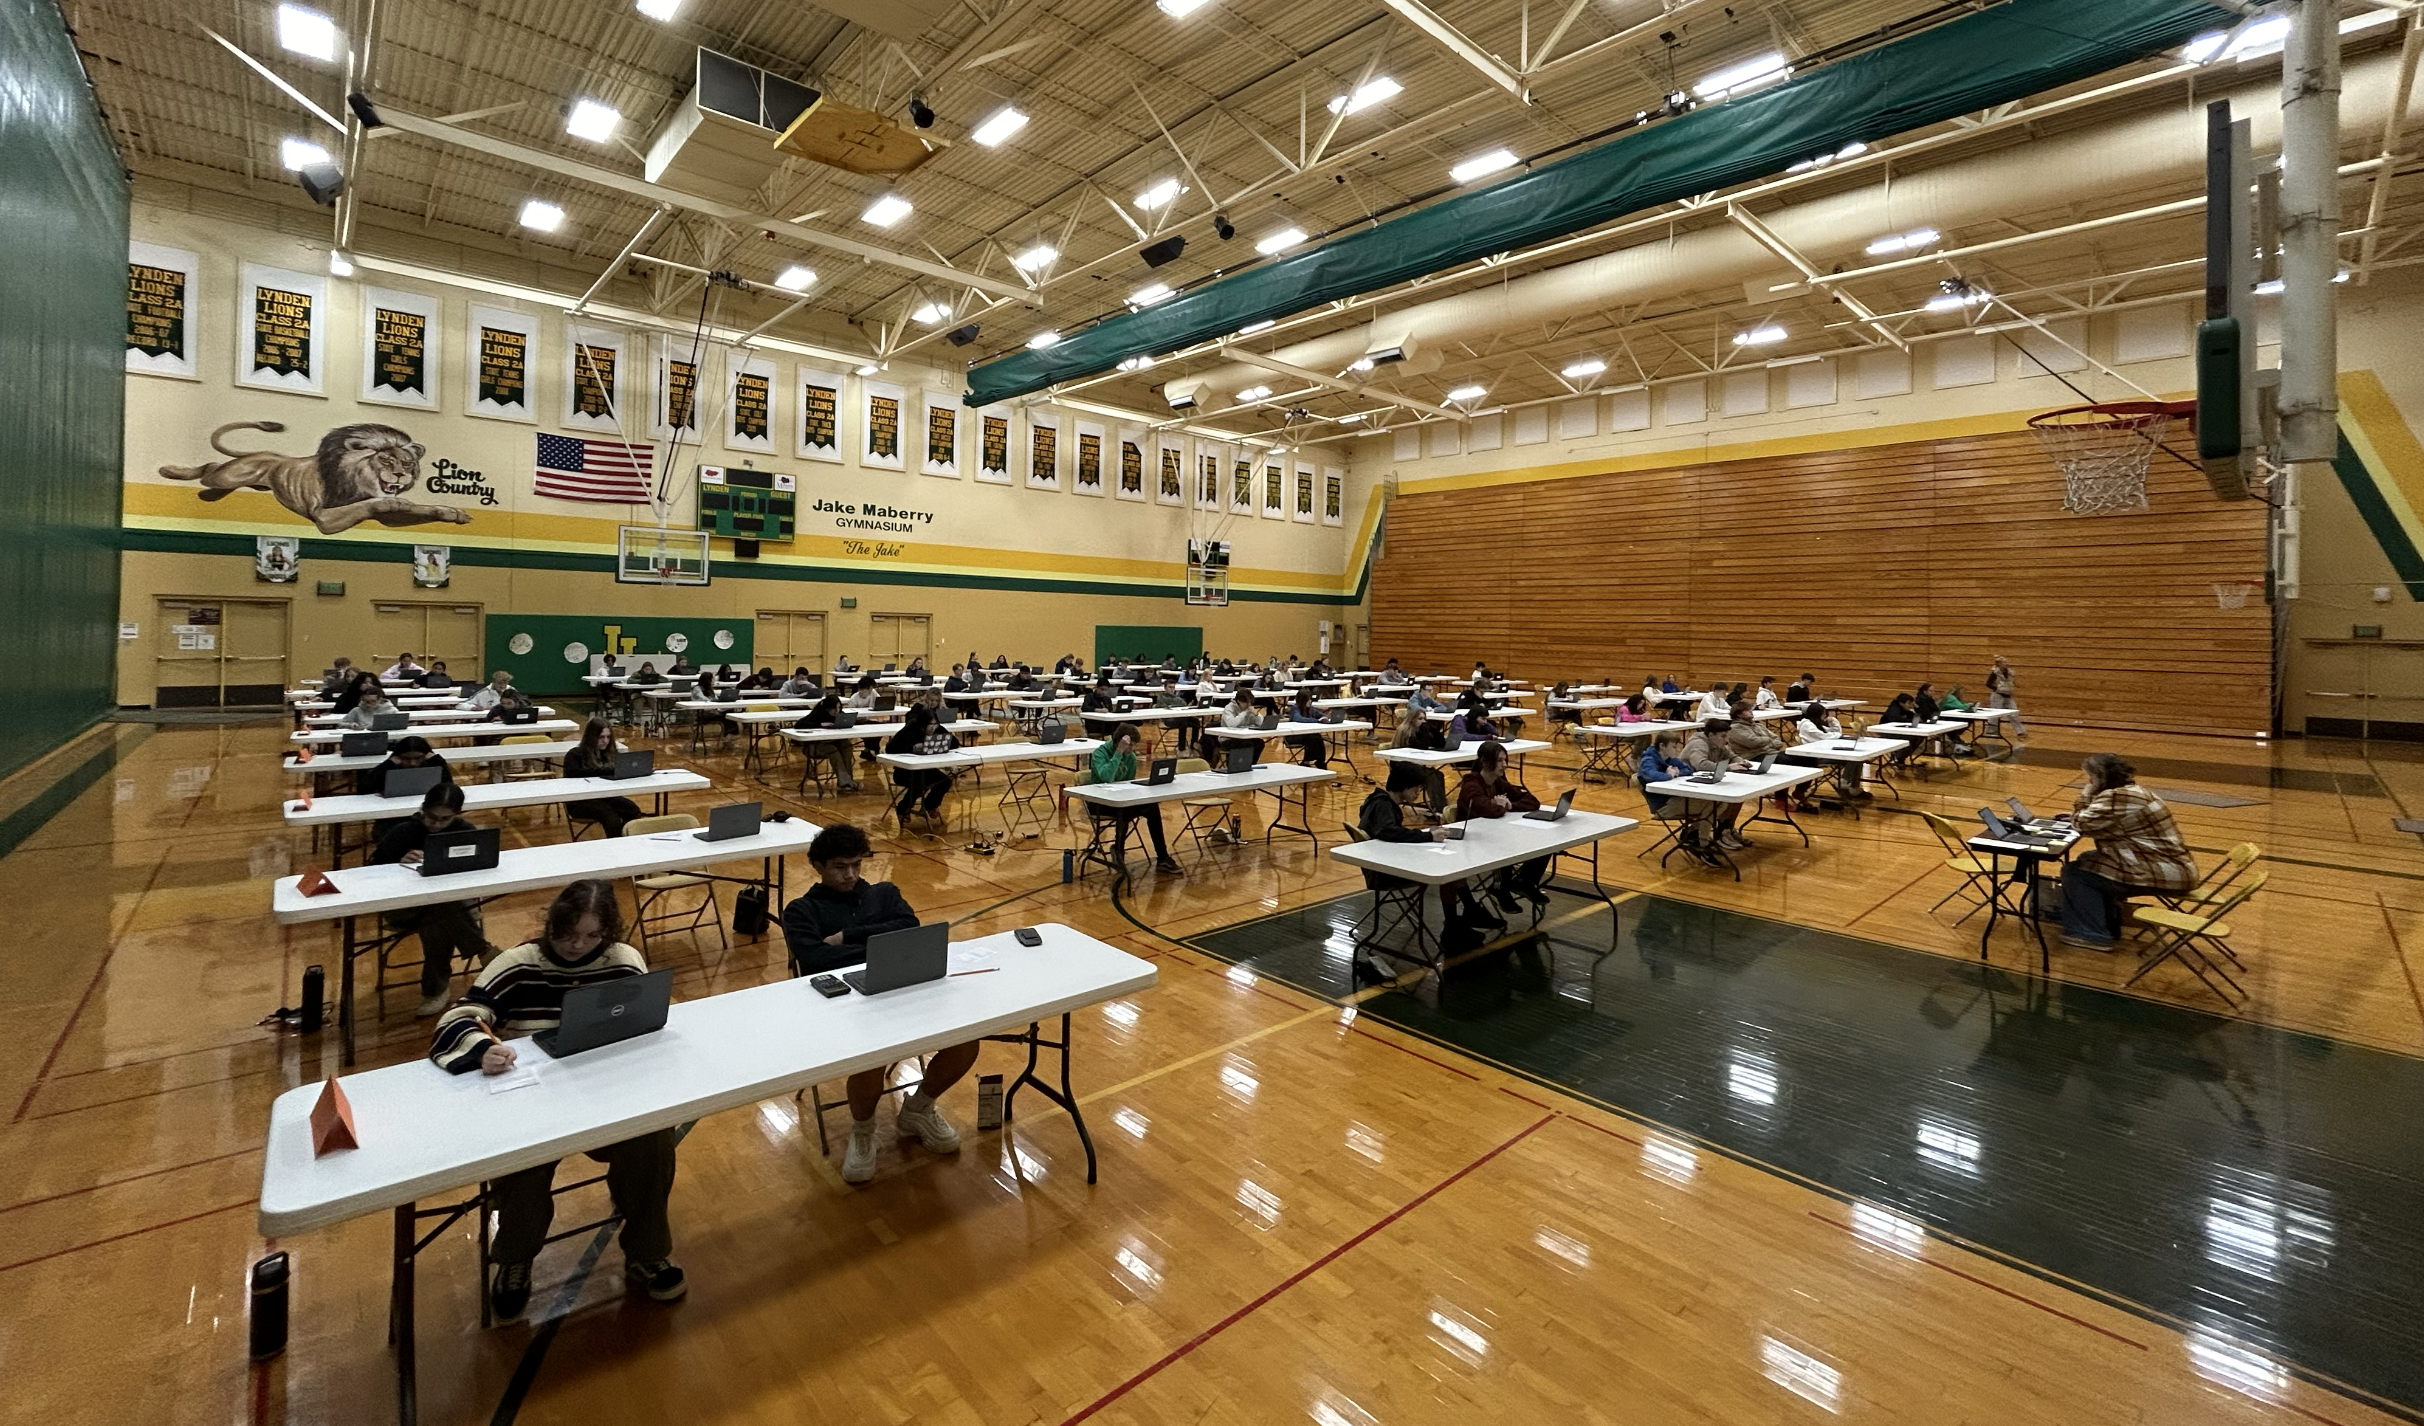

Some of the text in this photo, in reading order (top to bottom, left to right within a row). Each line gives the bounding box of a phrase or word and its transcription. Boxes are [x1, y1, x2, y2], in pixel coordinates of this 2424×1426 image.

[128, 265, 183, 286] YNDEN
[131, 279, 175, 297] LIONS
[128, 292, 183, 310] LASS 2A
[257, 288, 311, 308] LYNDEN
[264, 302, 303, 318] LIONS
[256, 312, 310, 329] CLASS 2A
[376, 310, 425, 327] LYNDEN
[382, 322, 418, 338] LIONS
[481, 329, 526, 346] LYNDEN
[375, 333, 423, 349] CLASS 2A
[485, 343, 521, 358] LIONS
[481, 355, 524, 370] CLASS 2A
[602, 372, 613, 381] 2A
[739, 388, 766, 400] LIONS
[806, 388, 836, 400] LYNDEN
[736, 398, 767, 410] CLASS 2A
[809, 399, 833, 411] LIONS
[870, 397, 898, 409] LYNDEN
[806, 410, 835, 421] CLASS 2A
[873, 406, 896, 418] LIONS
[870, 416, 897, 426] CLASS 2A
[932, 416, 952, 428] LIONS
[986, 426, 1005, 437] LIONS
[431, 458, 486, 482] Lion
[426, 476, 499, 506] Country
[703, 484, 729, 493] LYNDEN
[770, 491, 791, 499] GUEST
[812, 499, 934, 524] Jake Maberry
[835, 517, 913, 533] GYMNASIUM
[843, 540, 905, 559] "The Jake"
